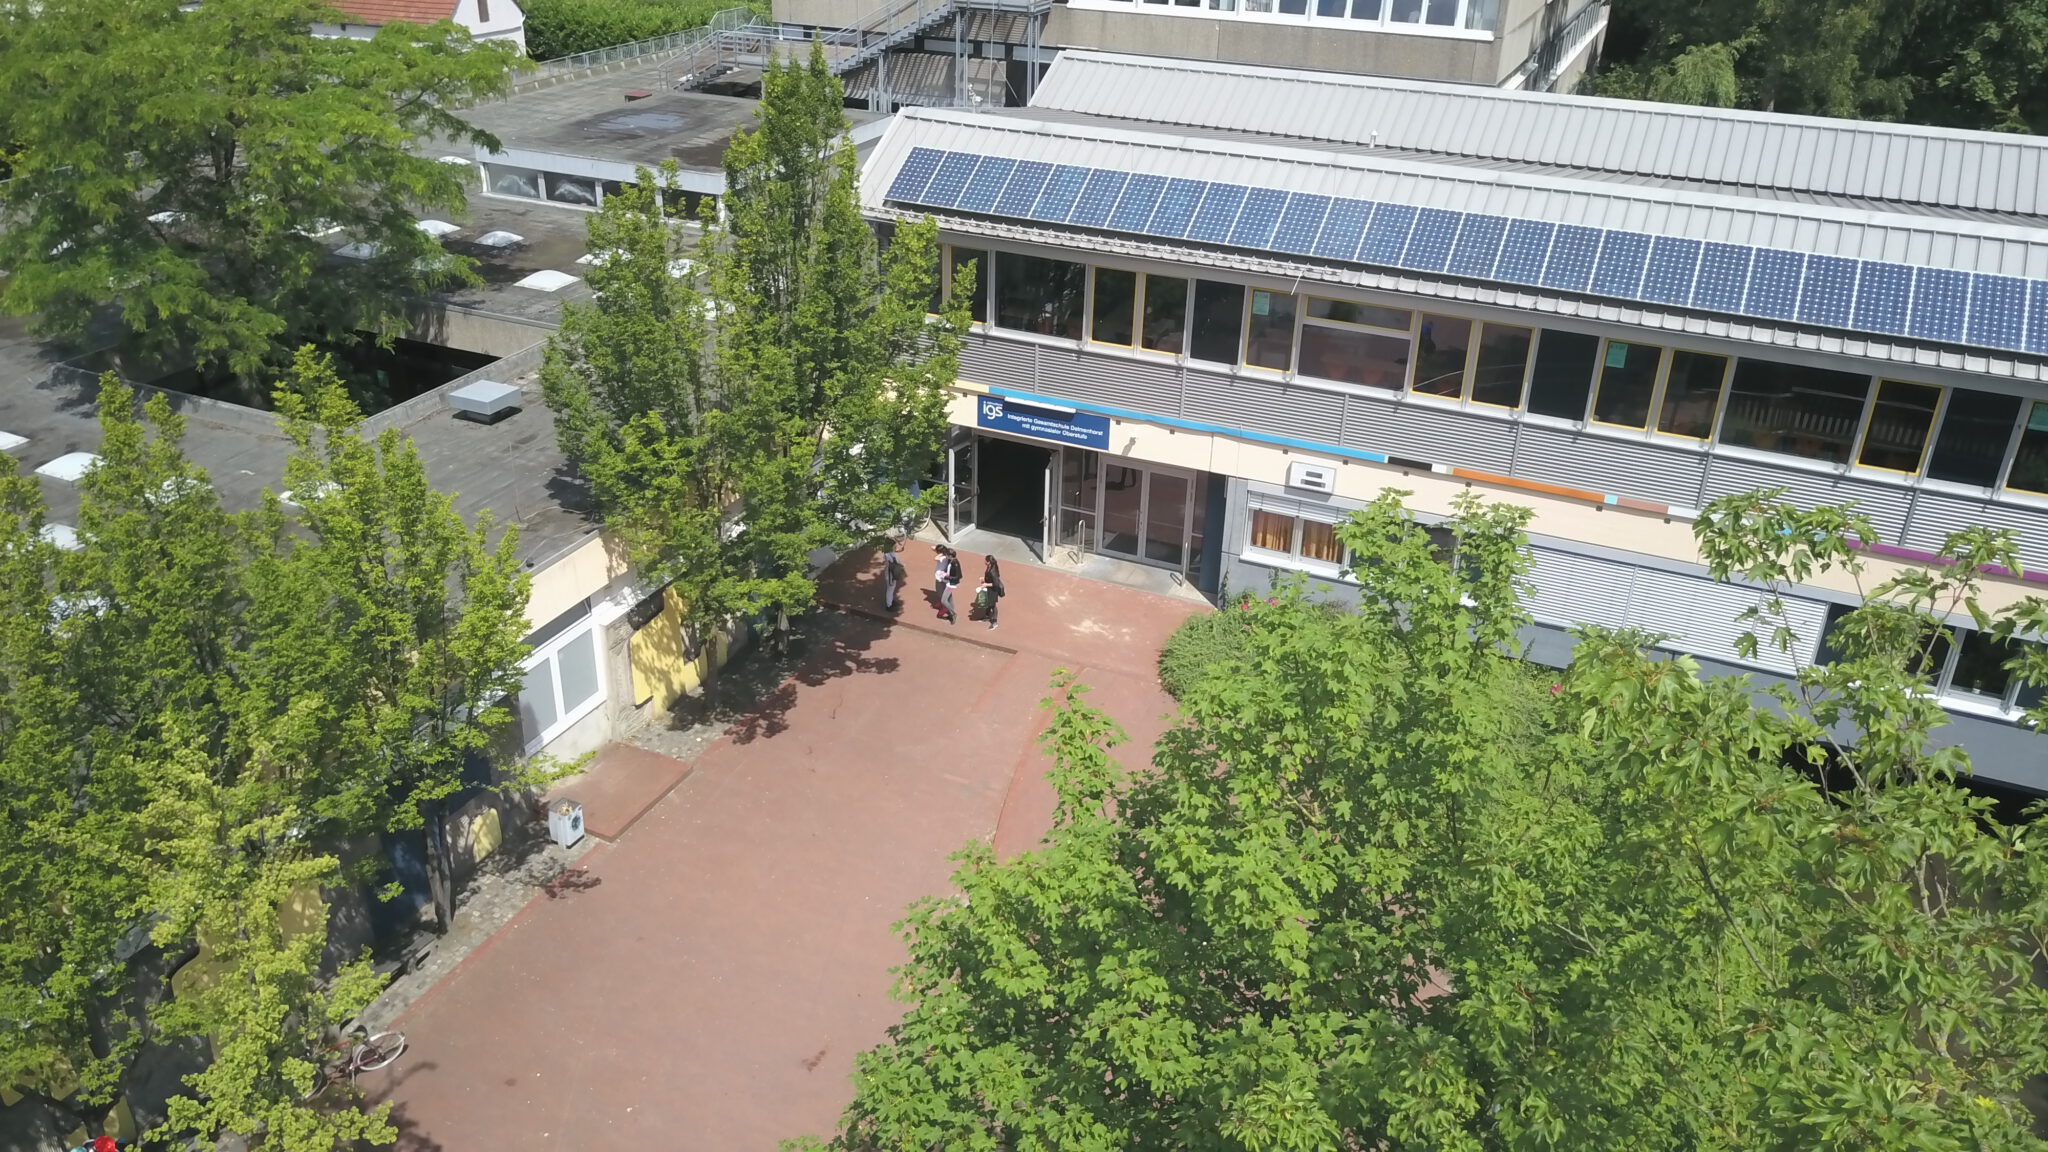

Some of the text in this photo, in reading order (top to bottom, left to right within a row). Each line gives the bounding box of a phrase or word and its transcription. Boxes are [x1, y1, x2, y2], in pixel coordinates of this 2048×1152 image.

[983, 401, 1003, 420] igs
[1007, 413, 1104, 436] Integrierte Gesamtschule Delmenhorst
[1031, 425, 1061, 435] gymnasialer
[1062, 430, 1088, 440] Oberstufe
